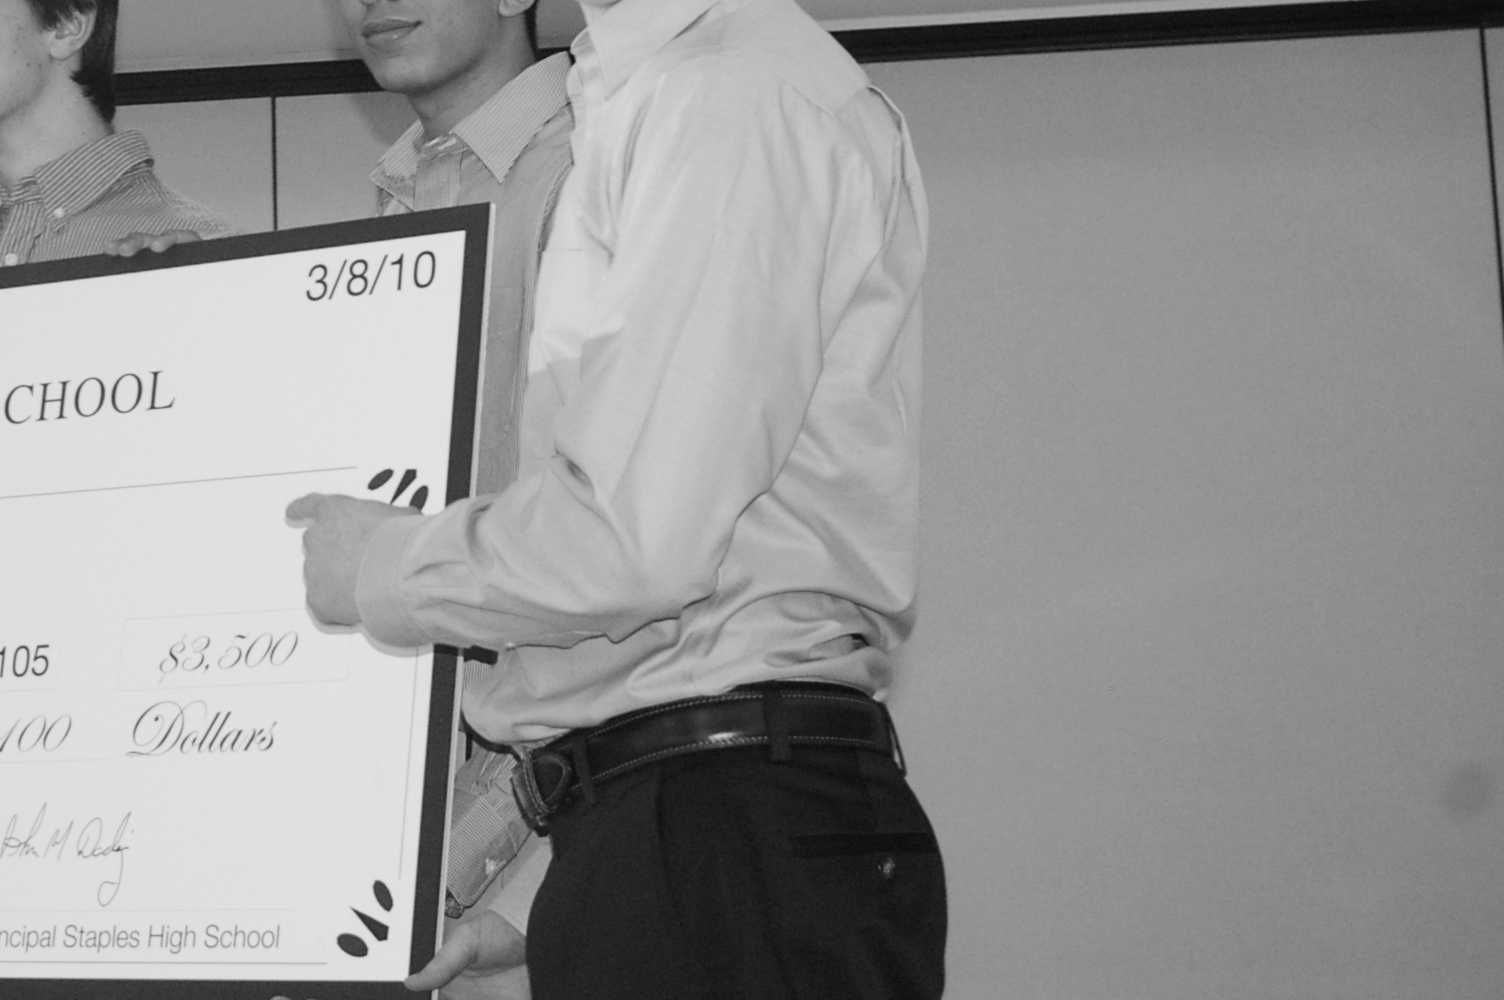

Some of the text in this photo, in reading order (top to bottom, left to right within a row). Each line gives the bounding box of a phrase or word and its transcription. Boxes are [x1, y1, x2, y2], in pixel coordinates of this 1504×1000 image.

[306, 250, 437, 301] 3/8/10
[126, 699, 278, 758] Dollars
[62, 923, 142, 954] Staples
[147, 925, 197, 955] High
[203, 923, 282, 950] School
